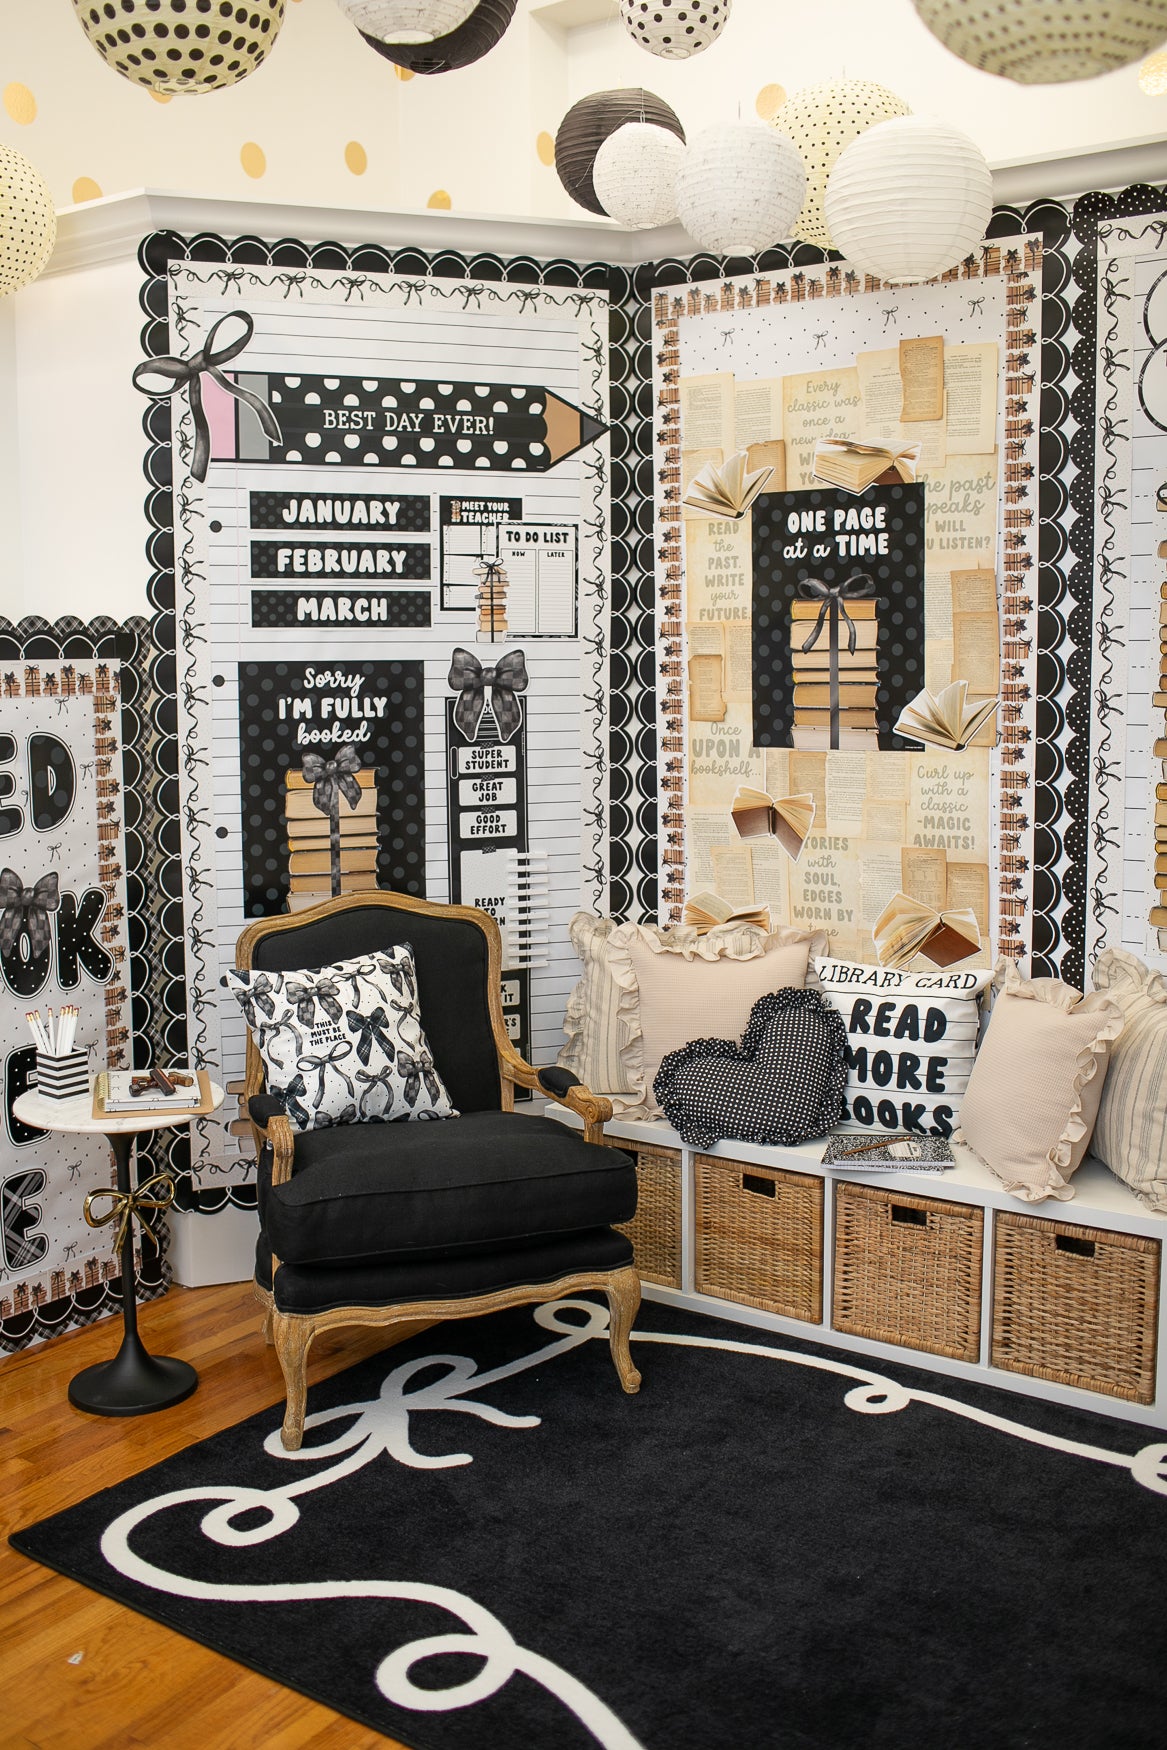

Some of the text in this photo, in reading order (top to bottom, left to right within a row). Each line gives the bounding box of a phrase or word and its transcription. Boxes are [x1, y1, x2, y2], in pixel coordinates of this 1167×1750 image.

[805, 380, 842, 397] Every
[787, 395, 861, 413] classic was
[323, 409, 494, 435] BEST DAY EVER!
[802, 415, 846, 428] once a
[791, 436, 817, 446] new
[949, 471, 997, 501] past
[282, 498, 401, 525] JANUARY
[461, 501, 510, 512] MEET YOUR
[925, 492, 986, 524] peaks
[461, 511, 510, 523] TEACHER
[787, 506, 886, 534] ONE PAGE
[708, 521, 740, 536] READ
[935, 519, 967, 533] WILL
[506, 531, 569, 544] TO DO LIST
[939, 536, 991, 550] LISTEN?
[713, 539, 735, 552] the
[783, 532, 889, 559] at a TIME
[277, 548, 407, 574] FEBRUARY
[708, 556, 742, 570] PAST.
[704, 573, 745, 588] WRITE
[711, 590, 740, 607] your
[297, 597, 389, 622] MARCH
[699, 606, 751, 621] FUTURE.
[303, 667, 366, 698] Sorry
[321, 696, 388, 719] FULLY
[297, 720, 372, 746] booked
[710, 722, 743, 736] Once
[471, 749, 503, 760] SUPER
[692, 738, 741, 759] UPON
[464, 759, 510, 771] STUDENT
[690, 759, 762, 778] bookshelf...
[917, 764, 975, 786] Curl up
[471, 782, 504, 792] GREAT
[920, 781, 969, 796] with a
[478, 792, 498, 803] JOB
[920, 796, 969, 814] classic
[475, 814, 501, 825] GOOD
[470, 823, 507, 835] EFFORT
[913, 833, 976, 850] AWAITS!
[807, 855, 837, 868] with
[804, 871, 841, 888] SOUL,
[474, 896, 506, 908] READY
[803, 889, 843, 904] EDGES
[793, 905, 854, 923] WORN BY
[819, 964, 978, 990] LIBRARY CARD
[315, 1020, 332, 1029] THIS
[849, 998, 948, 1043] READ
[310, 1026, 342, 1038] MUST BE
[310, 1033, 347, 1047] THE PLACE
[843, 1046, 948, 1093] MORE
